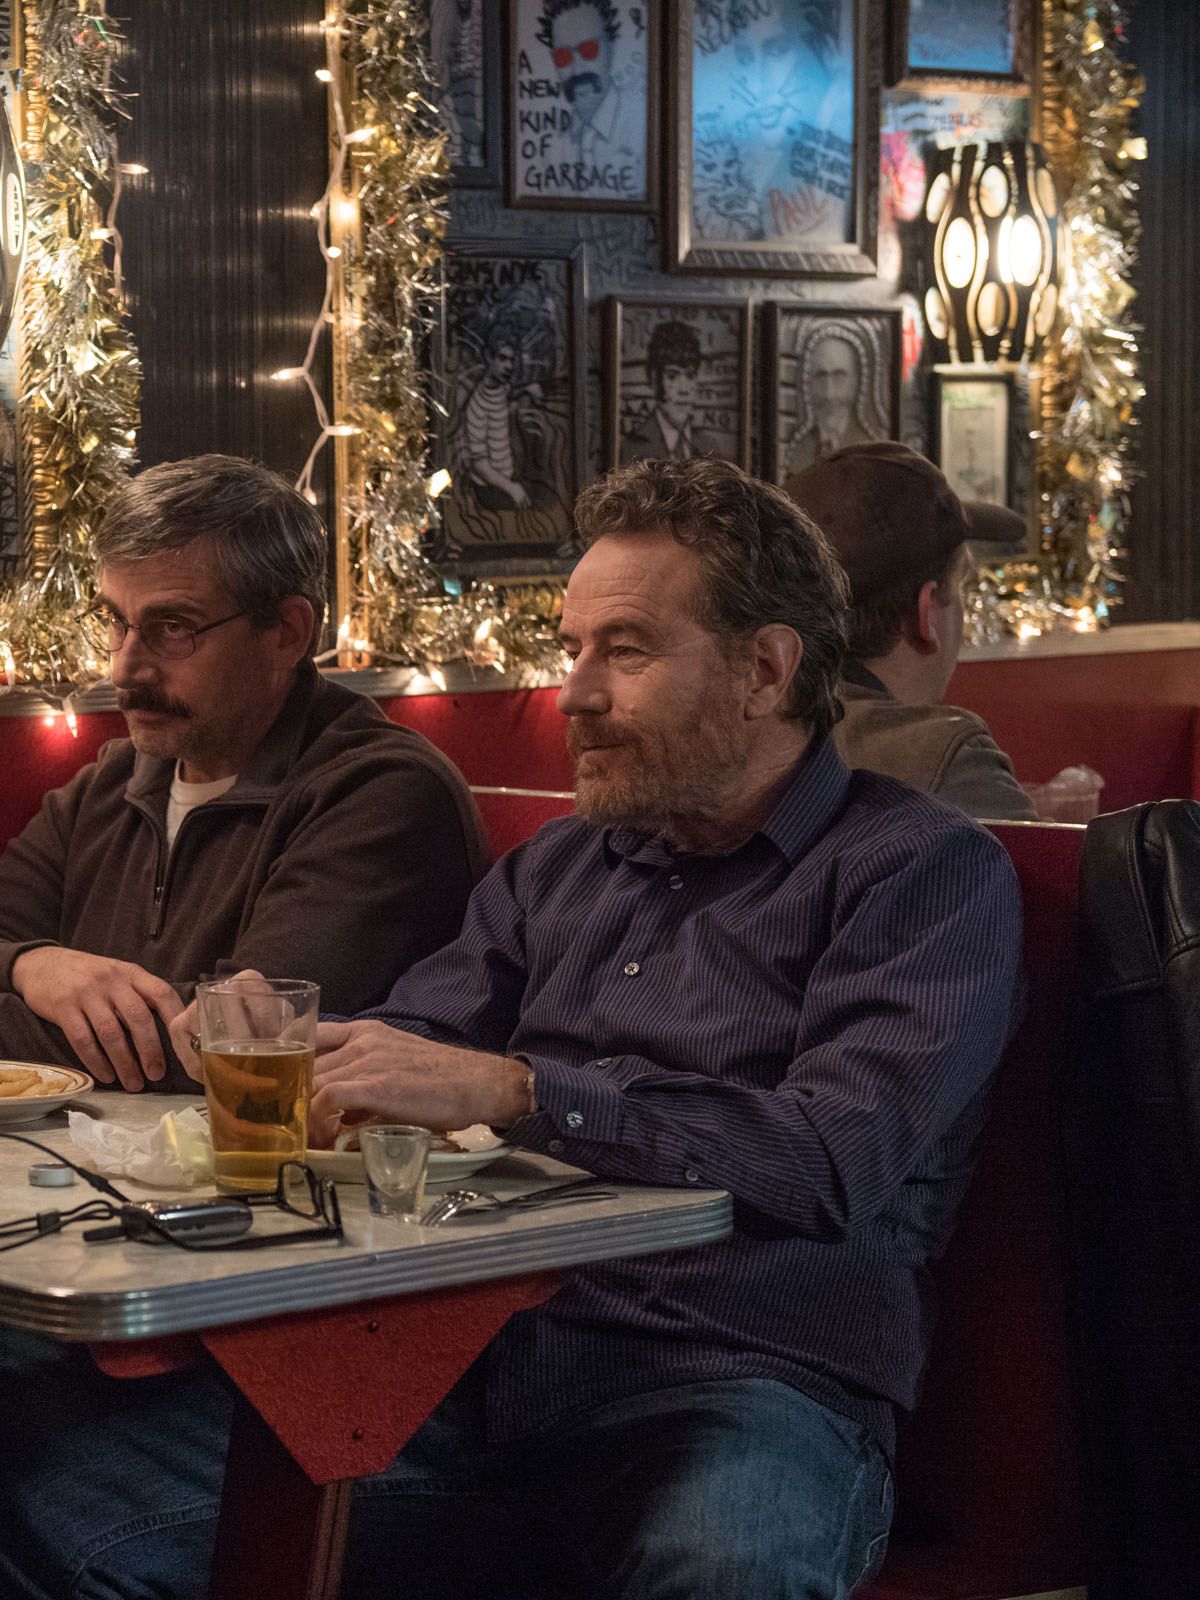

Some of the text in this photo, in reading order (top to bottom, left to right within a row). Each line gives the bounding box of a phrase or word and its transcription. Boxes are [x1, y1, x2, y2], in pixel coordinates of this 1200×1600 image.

[519, 50, 532, 74] A
[519, 79, 561, 99] NEW
[519, 107, 572, 133] KIND
[521, 134, 552, 159] OF
[524, 161, 637, 192] GARBAGE
